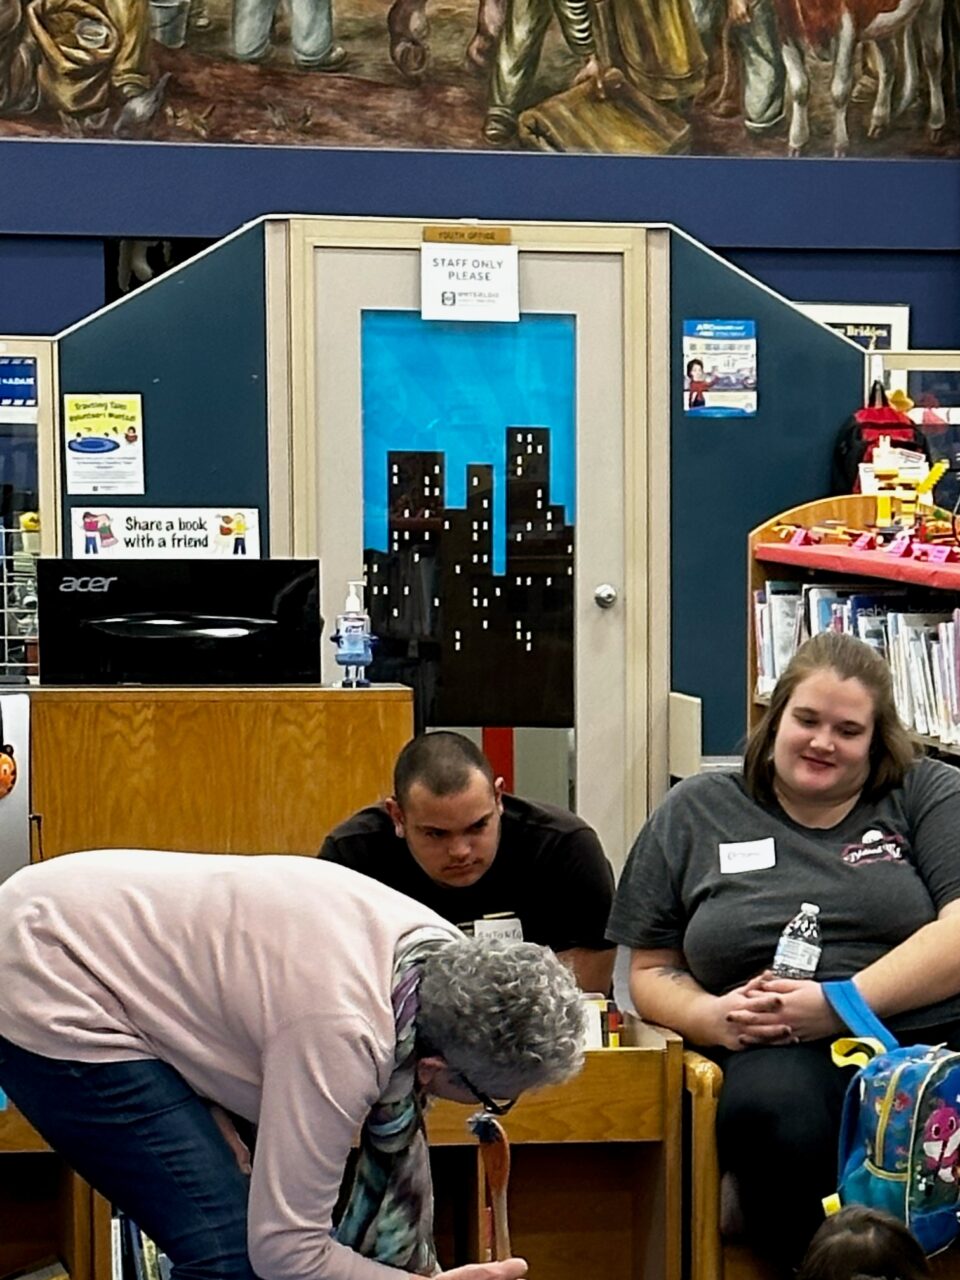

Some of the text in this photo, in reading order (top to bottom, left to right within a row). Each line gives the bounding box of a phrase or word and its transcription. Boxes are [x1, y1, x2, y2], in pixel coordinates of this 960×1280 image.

[432, 257, 503, 270] STAFF ONLY
[448, 271, 491, 281] PLEASE
[125, 516, 208, 531] Share a book
[124, 533, 208, 548] with a friend
[59, 577, 118, 592] acer
